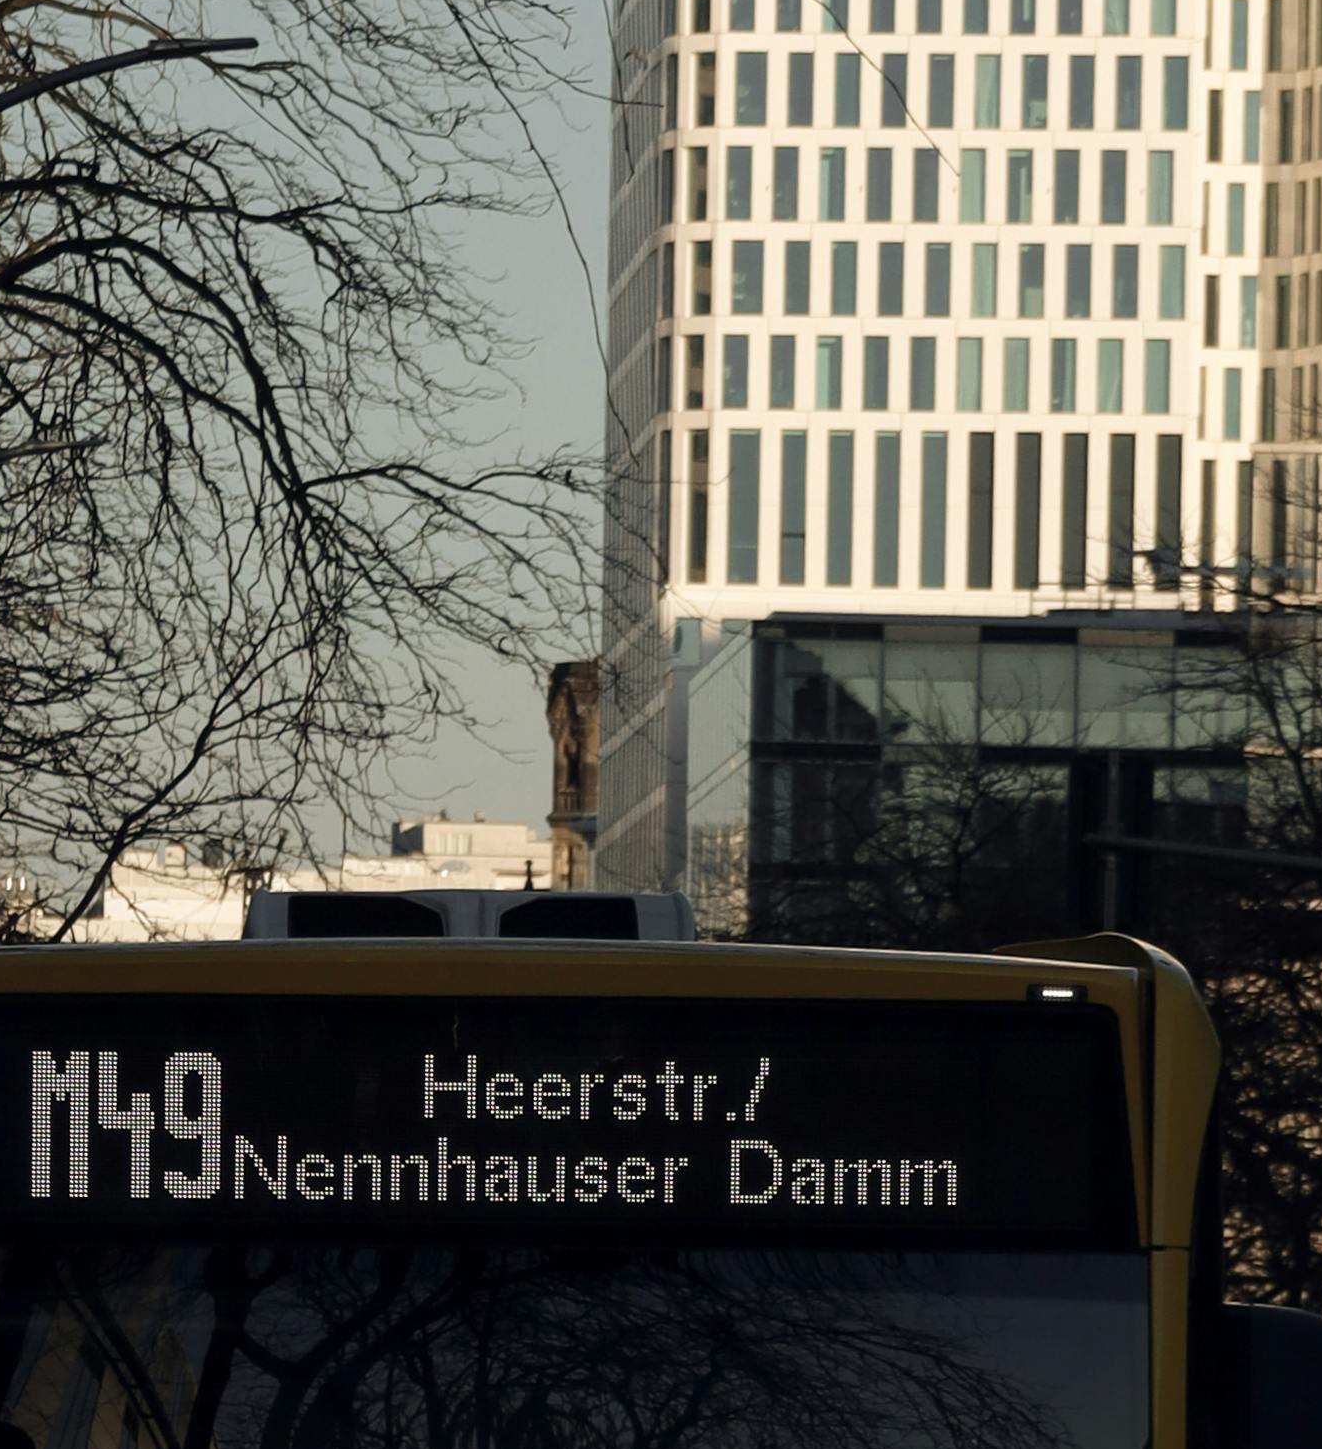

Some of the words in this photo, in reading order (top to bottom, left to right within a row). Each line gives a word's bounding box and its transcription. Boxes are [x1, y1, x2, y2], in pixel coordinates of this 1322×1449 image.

[423, 1053, 770, 1122] Heerstr./
[31, 1050, 223, 1200] M49
[234, 1134, 690, 1204] Nennhauser
[730, 1139, 959, 1206] Damm
